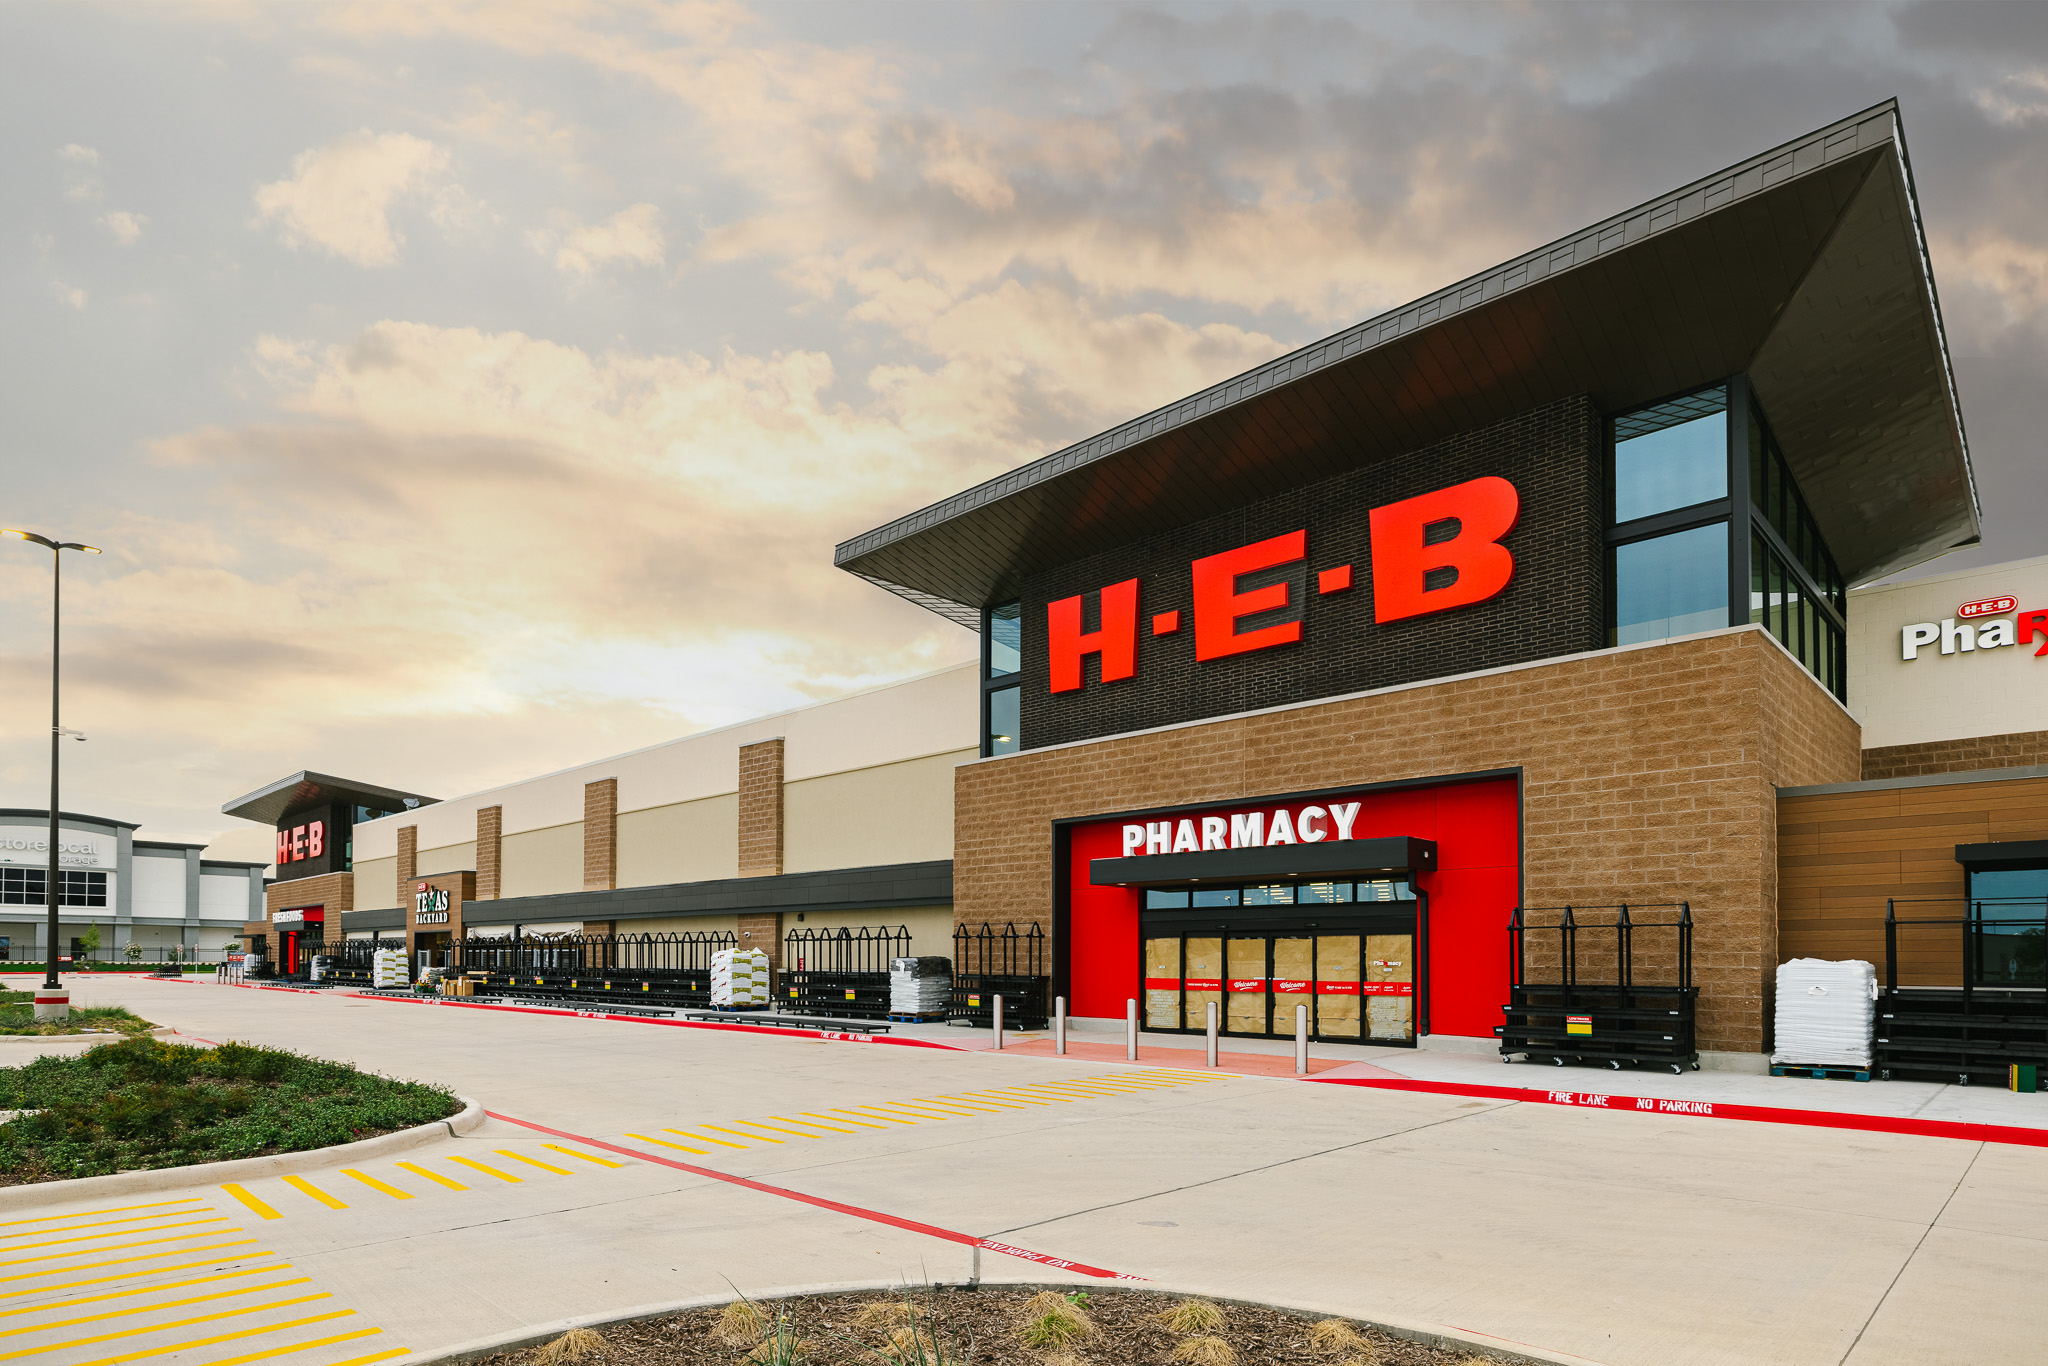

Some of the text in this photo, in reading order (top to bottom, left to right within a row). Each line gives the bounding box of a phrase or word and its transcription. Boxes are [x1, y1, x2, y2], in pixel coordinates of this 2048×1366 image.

[1048, 476, 1522, 694] H-E-B
[1122, 802, 1362, 857] PHARMACY
[416, 890, 449, 913] TEXAS
[416, 912, 449, 924] BACKYARD
[1233, 981, 1259, 989] Welcome
[1279, 981, 1306, 990] Welcome
[1548, 1091, 1713, 1115] FIRE LANE NO PARKING
